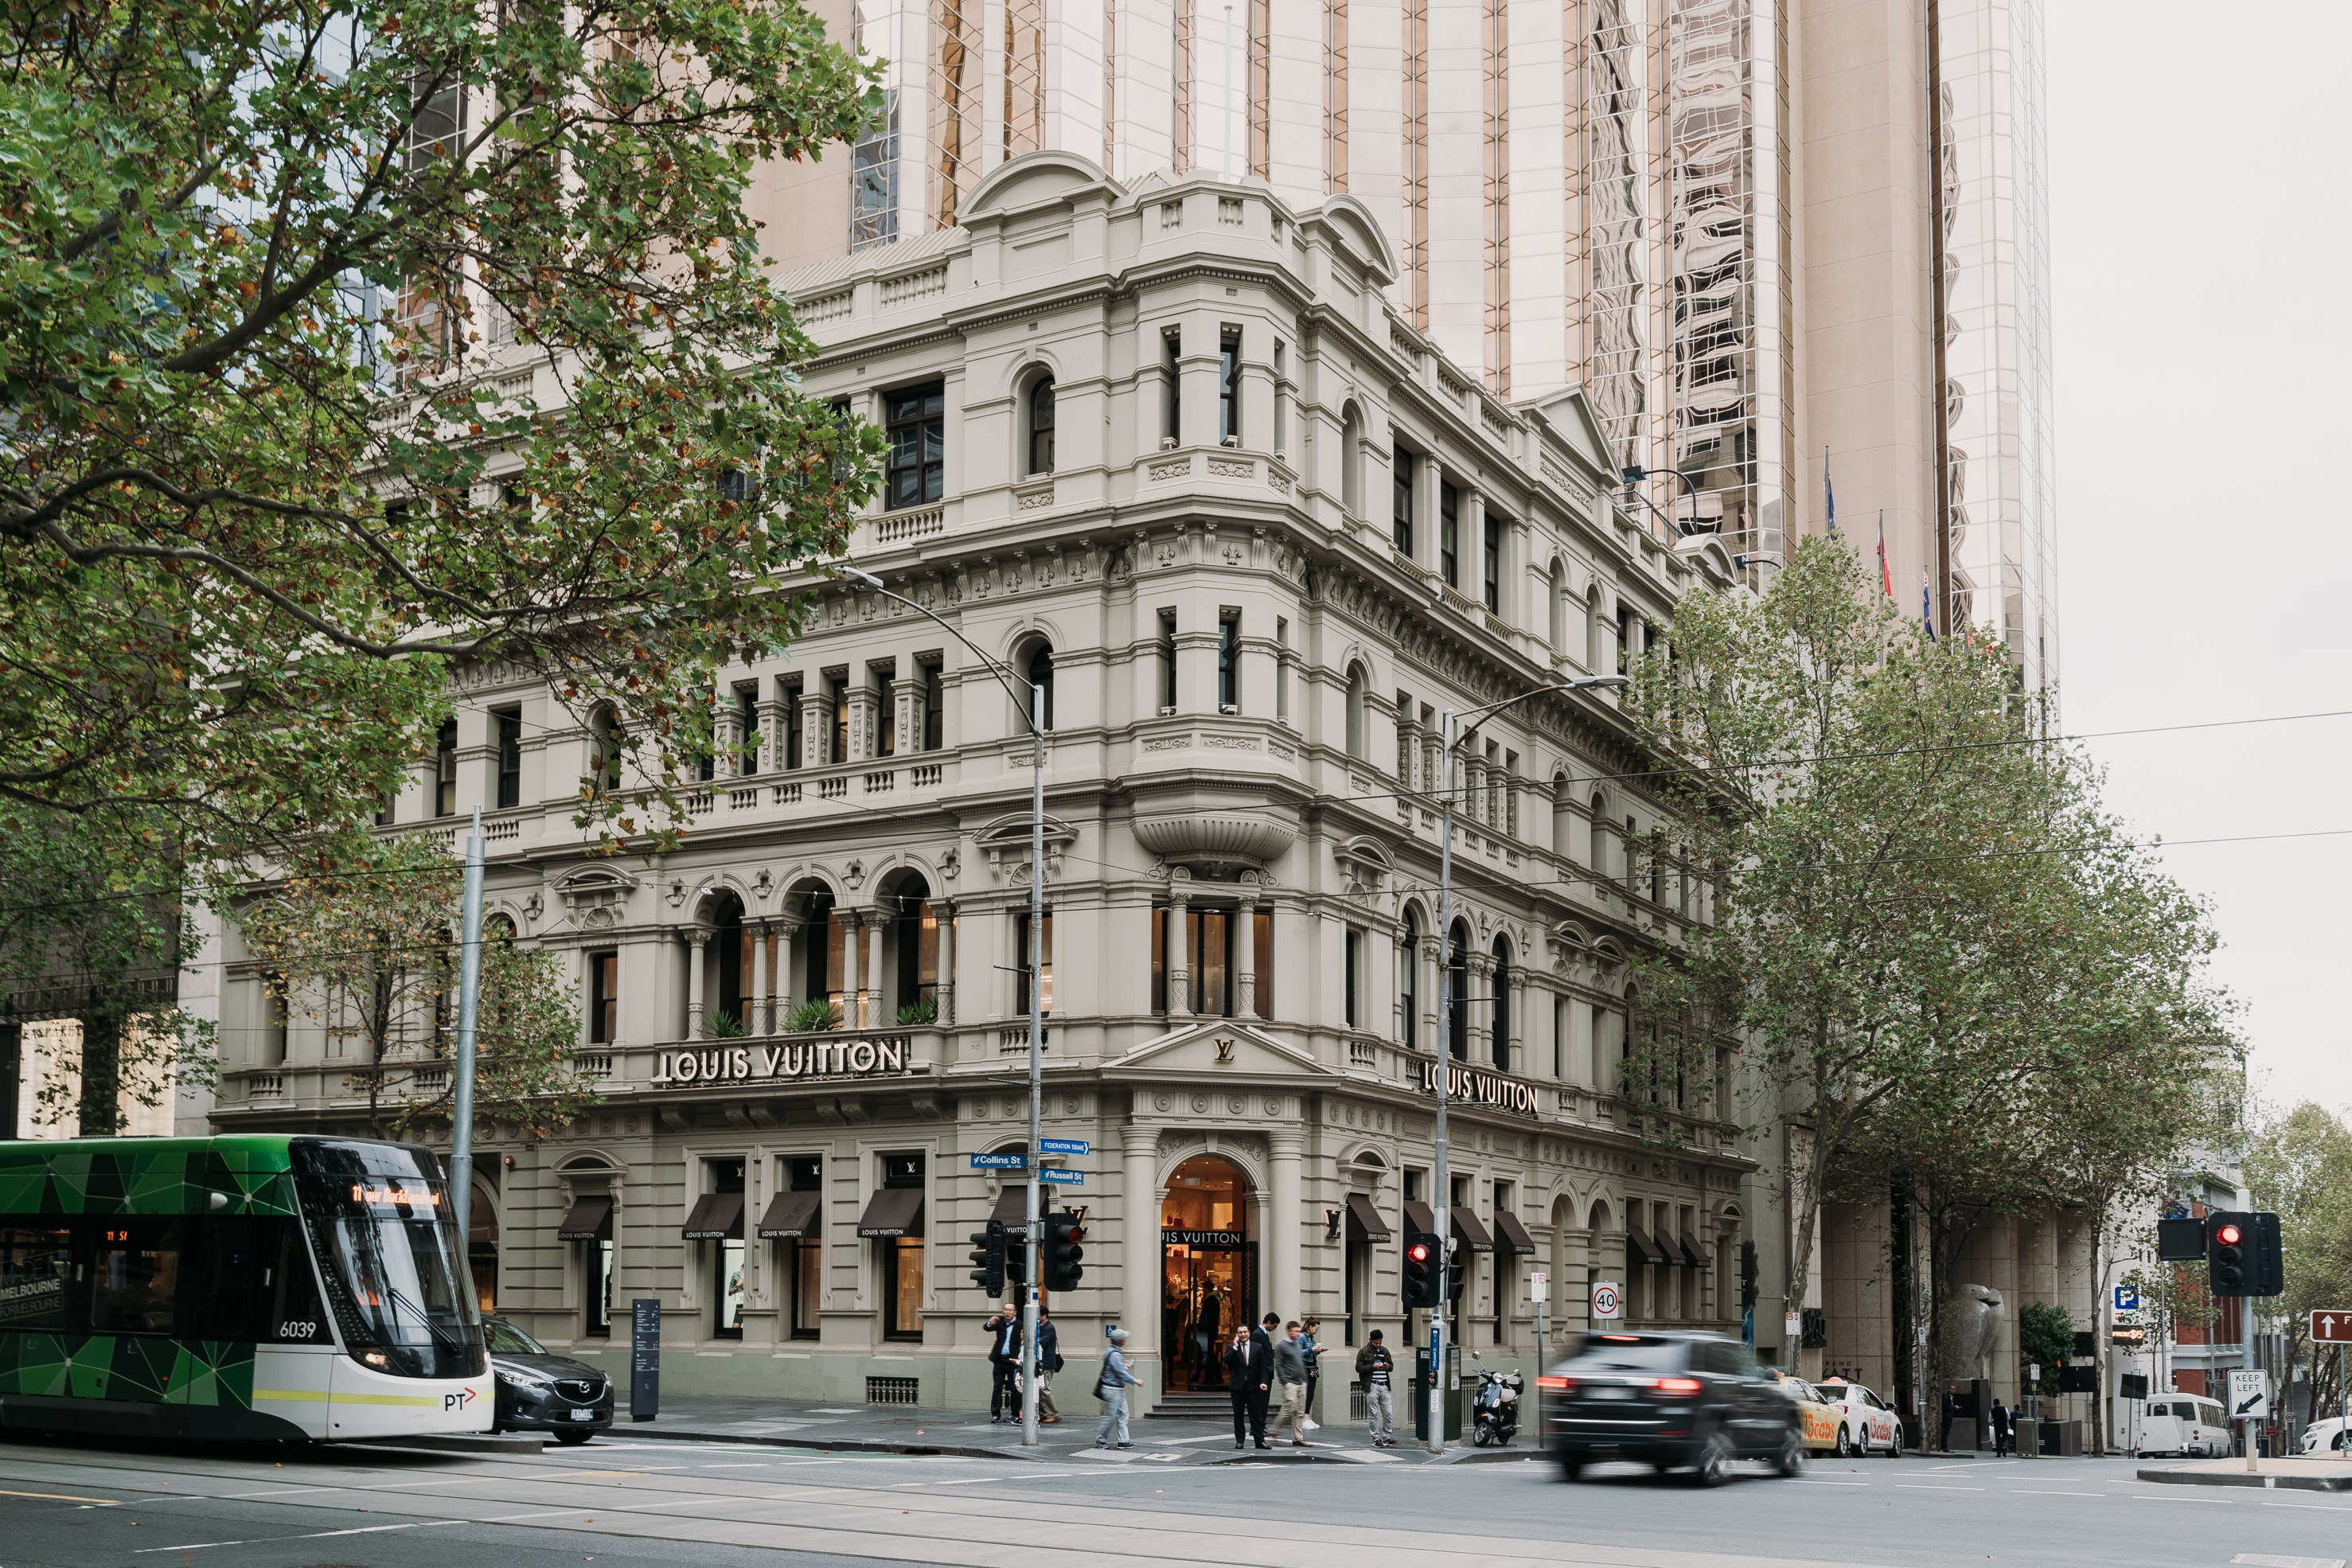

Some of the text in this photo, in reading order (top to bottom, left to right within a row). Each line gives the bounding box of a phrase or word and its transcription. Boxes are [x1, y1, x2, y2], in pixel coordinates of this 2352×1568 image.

[662, 1040, 903, 1082] LOUIS VUITTON
[1425, 1061, 1538, 1113] LOUIS VUITTON
[979, 1156, 1021, 1164] Collins St
[1050, 1170, 1073, 1180] Russell
[353, 1185, 362, 1202] 11
[1183, 1233, 1240, 1243] VUITTON
[0, 1278, 61, 1301] MELBOURNE
[1597, 1294, 1614, 1307] 40
[280, 1321, 316, 1338] 6039
[1823, 1368, 1862, 1380] YATT
[1804, 1414, 1835, 1441] 13cabs
[1870, 1415, 1891, 1441] 13cabs
